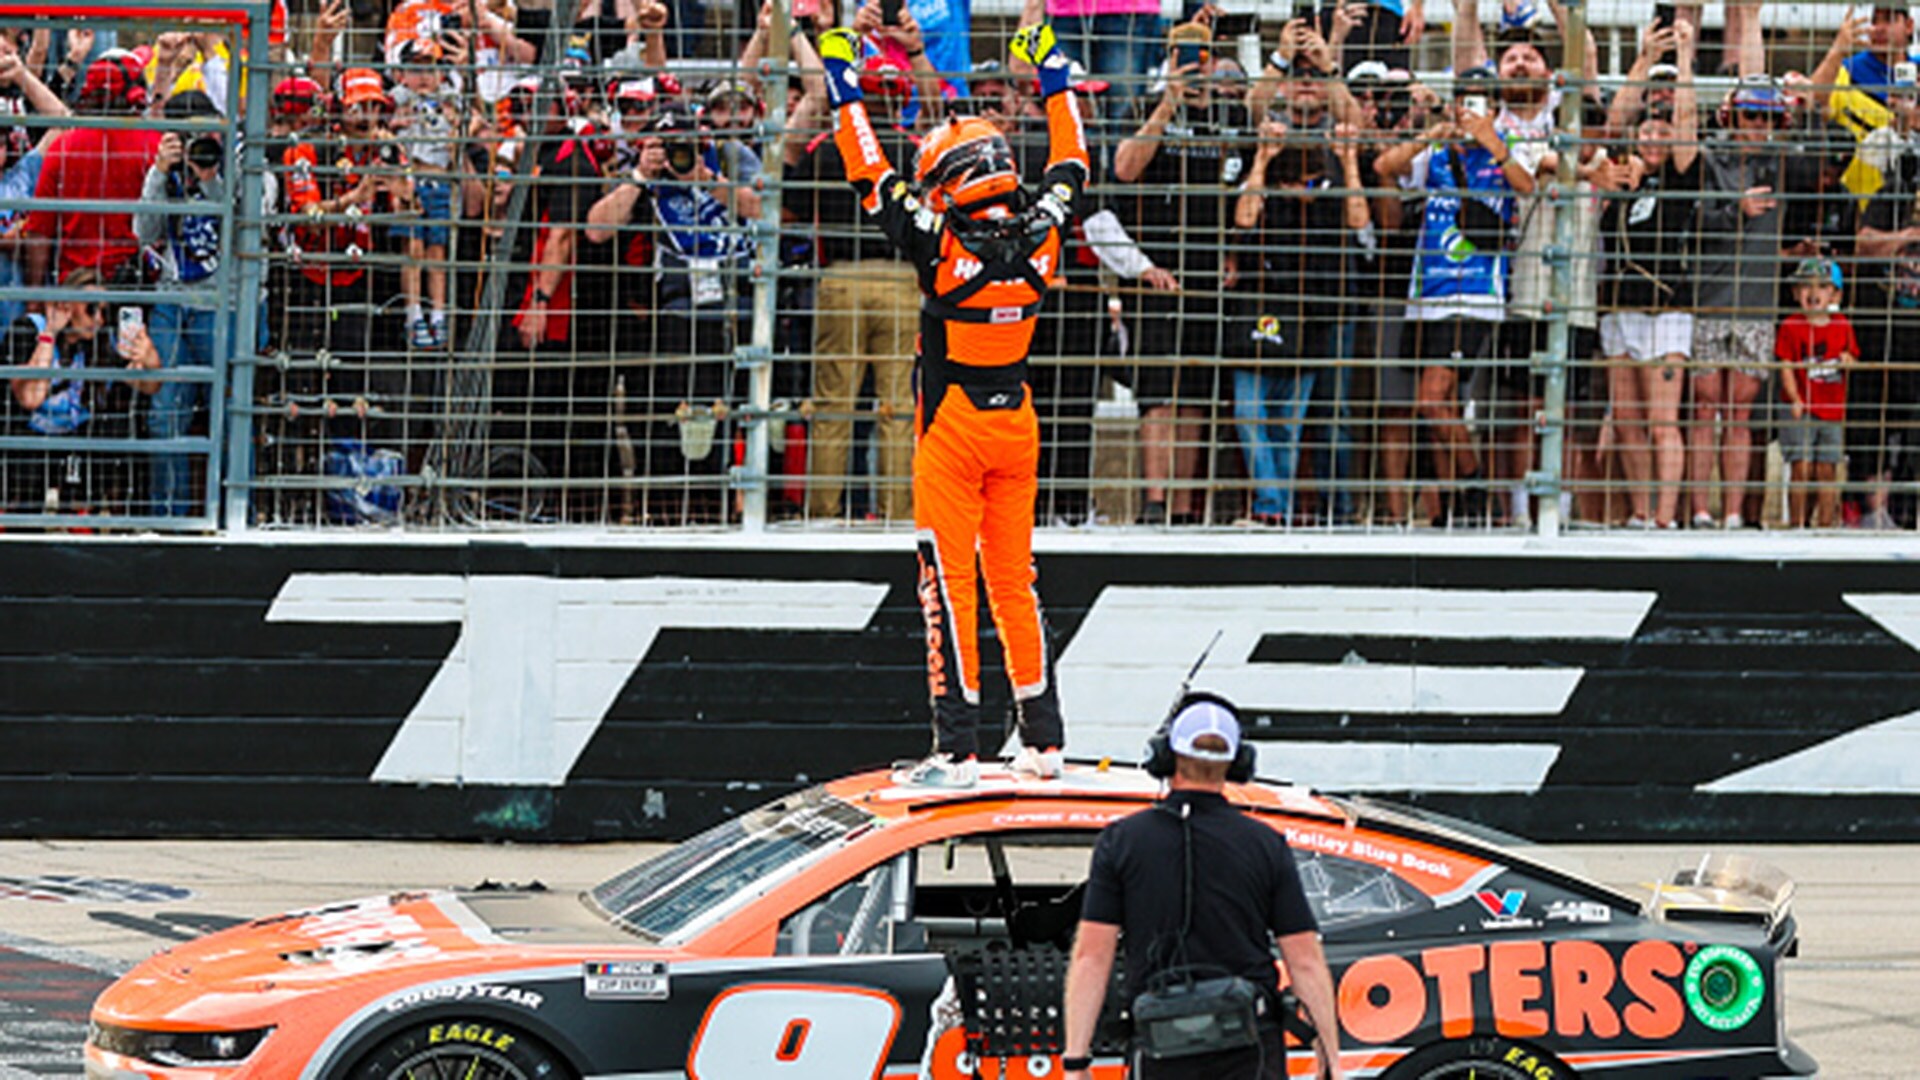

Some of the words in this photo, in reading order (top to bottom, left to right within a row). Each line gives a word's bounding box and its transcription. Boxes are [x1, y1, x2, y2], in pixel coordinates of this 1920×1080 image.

[266, 573, 1920, 797] TE
[1284, 826, 1349, 854] Kelley
[1351, 839, 1398, 863] Blue
[1401, 852, 1453, 878] Book
[385, 983, 544, 1012] GOODYEAR
[1275, 938, 1686, 1044] OTERS
[428, 1023, 516, 1052] EAGLE
